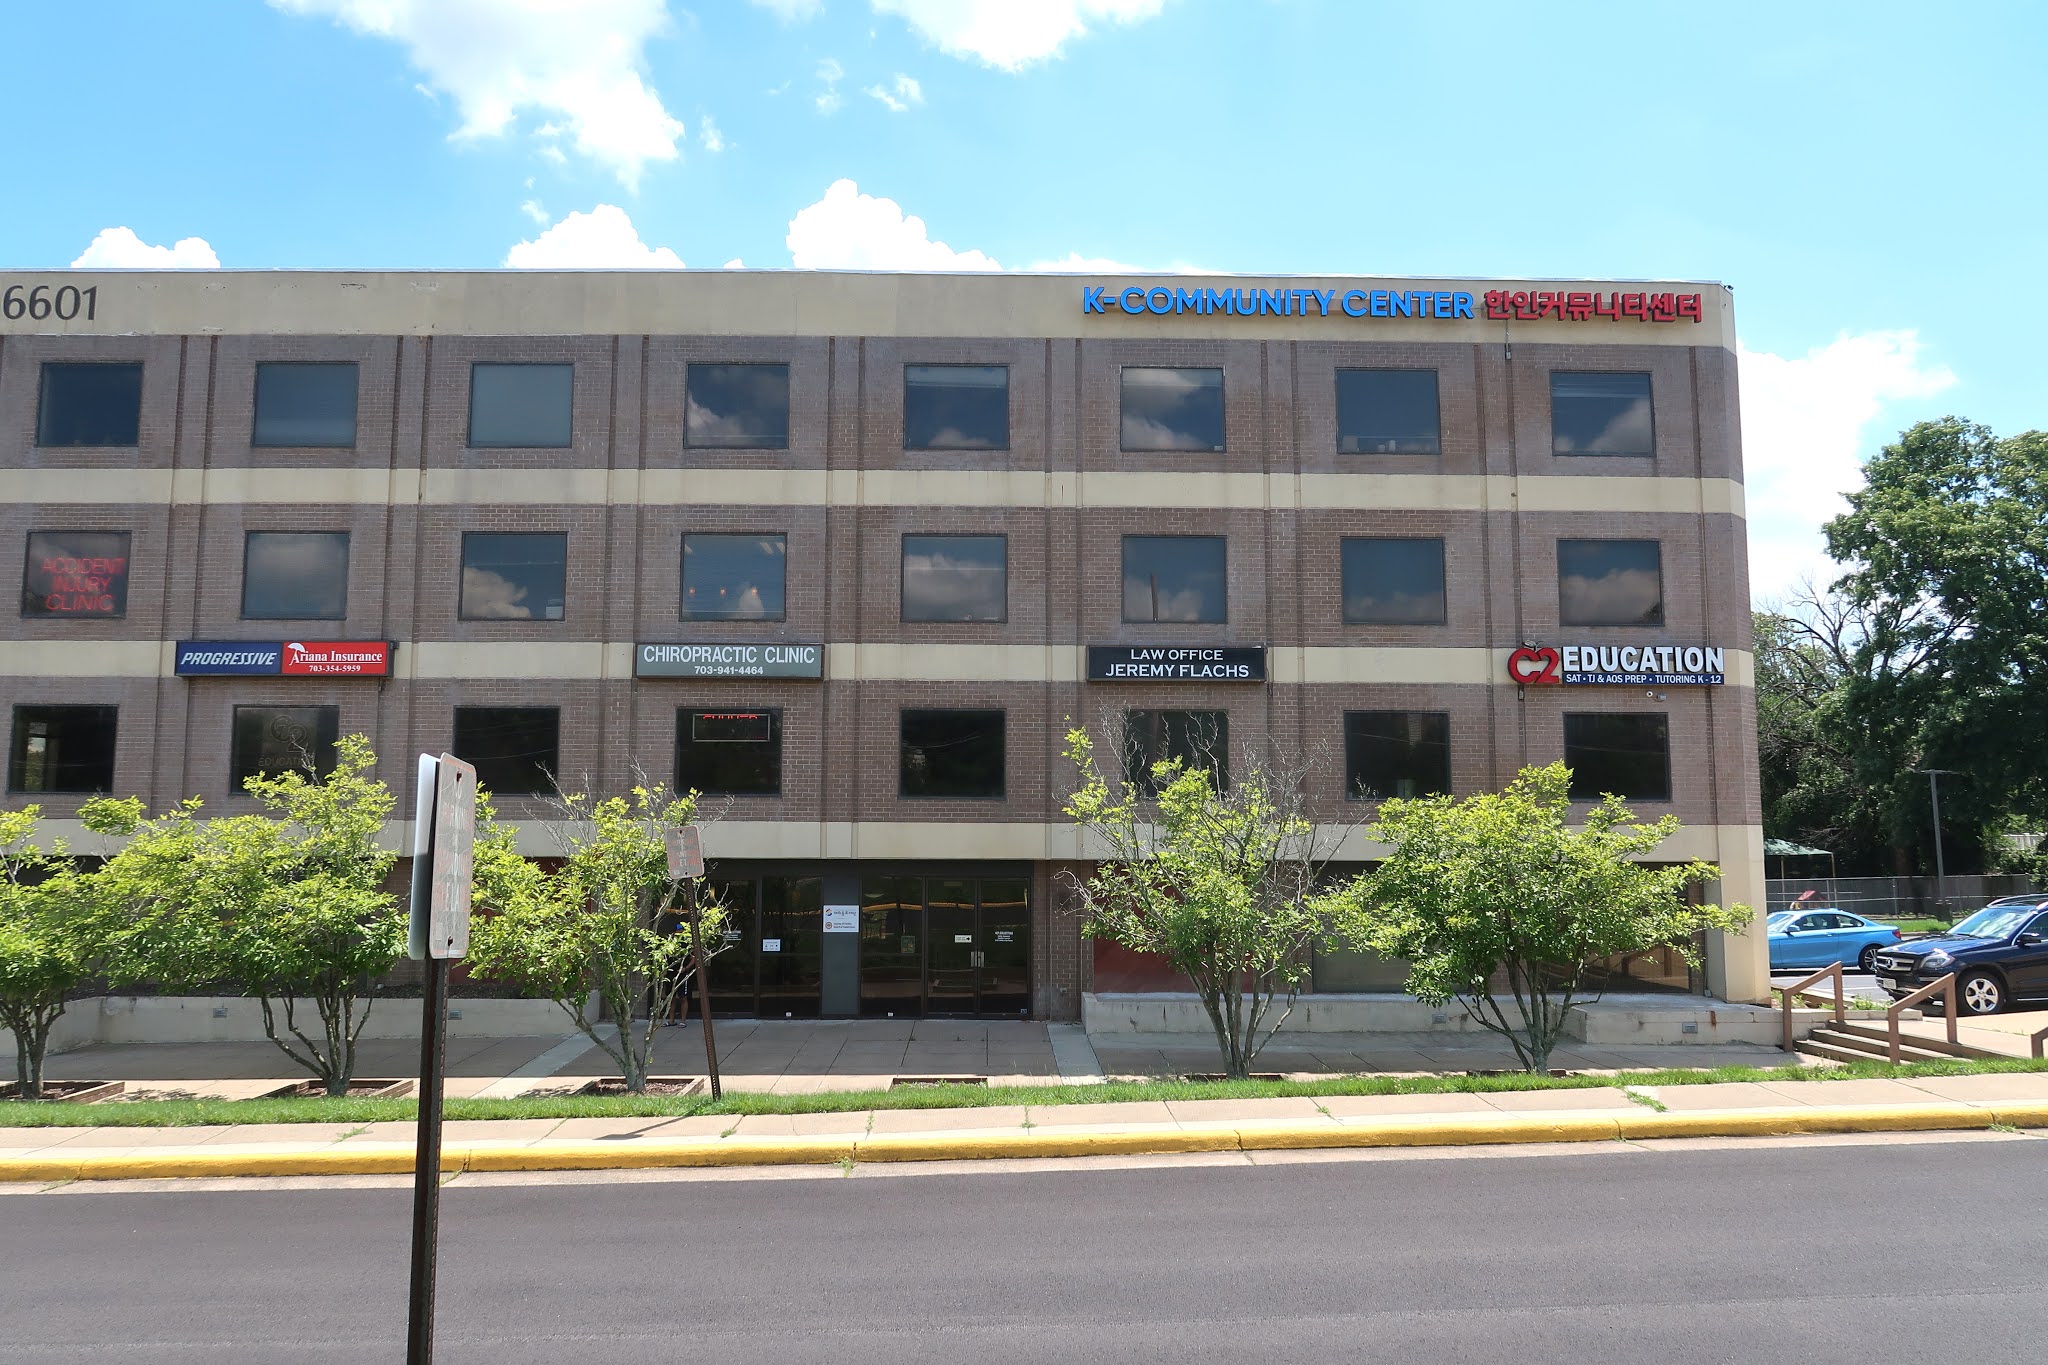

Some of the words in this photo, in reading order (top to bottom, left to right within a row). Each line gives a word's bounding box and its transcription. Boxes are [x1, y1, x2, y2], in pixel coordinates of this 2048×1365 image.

[3, 285, 97, 321] 6601
[1083, 286, 1336, 316] K-COMMUNITY
[1342, 289, 1475, 319] CENTER
[1484, 290, 1702, 323] 한인커뮤니티센터
[42, 557, 127, 574] ACCIDENT
[53, 576, 112, 592] INJURY
[46, 594, 114, 611] CLINIC
[181, 652, 277, 665] PROGRESSIVE
[289, 650, 328, 665] Ariana
[331, 651, 383, 662] Insurance
[643, 645, 757, 663] CHIROPRACTIC
[764, 646, 815, 664] CLINIC
[1130, 649, 1165, 660] LAW
[1168, 649, 1223, 661] OFFICE
[1562, 646, 1725, 673] EDUCATION
[694, 666, 764, 675] 703-941-4464
[1106, 664, 1175, 677] JEREMY
[1180, 664, 1249, 678] FLACHS
[1508, 646, 1560, 684] C2
[1566, 674, 1582, 683] SAT
[1587, 674, 1596, 683] TJ
[1597, 675, 1604, 683] &
[1606, 675, 1623, 683] AOS
[1625, 675, 1647, 683] PREP
[1655, 675, 1696, 684] TUTORING
[258, 757, 316, 768] EDUCATI
